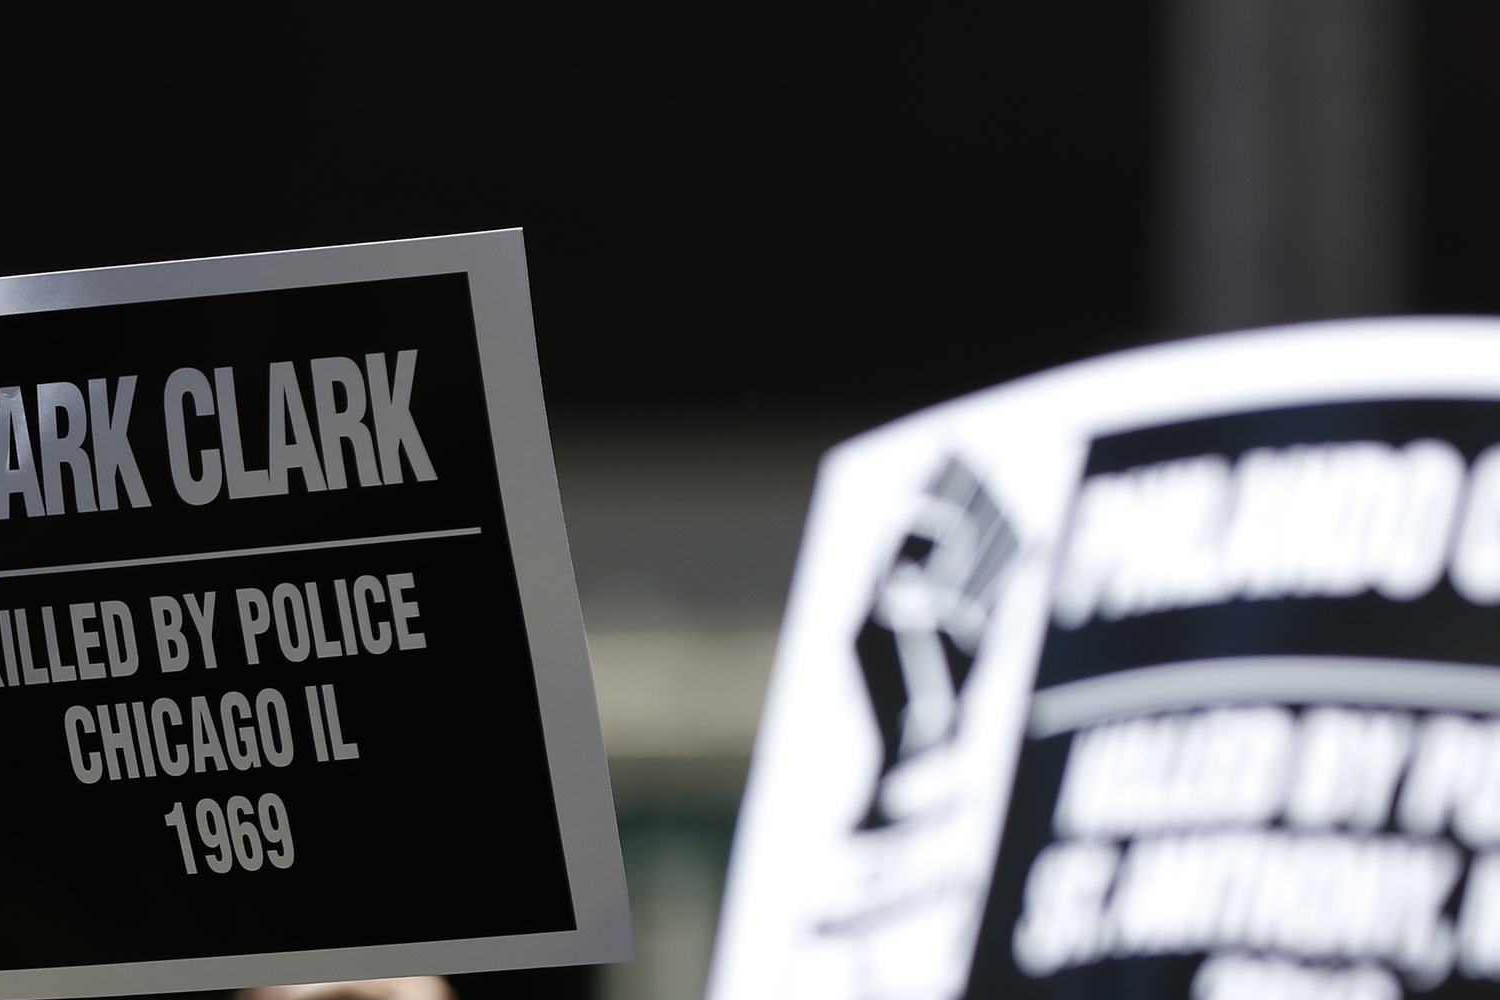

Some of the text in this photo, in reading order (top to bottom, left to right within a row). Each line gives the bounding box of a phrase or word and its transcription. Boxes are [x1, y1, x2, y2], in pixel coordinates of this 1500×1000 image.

[163, 349, 438, 506] CLARK
[150, 591, 217, 674] BY
[236, 572, 427, 666] POLICE
[64, 684, 360, 785] CHICAGO IL
[164, 793, 295, 875] 1969
